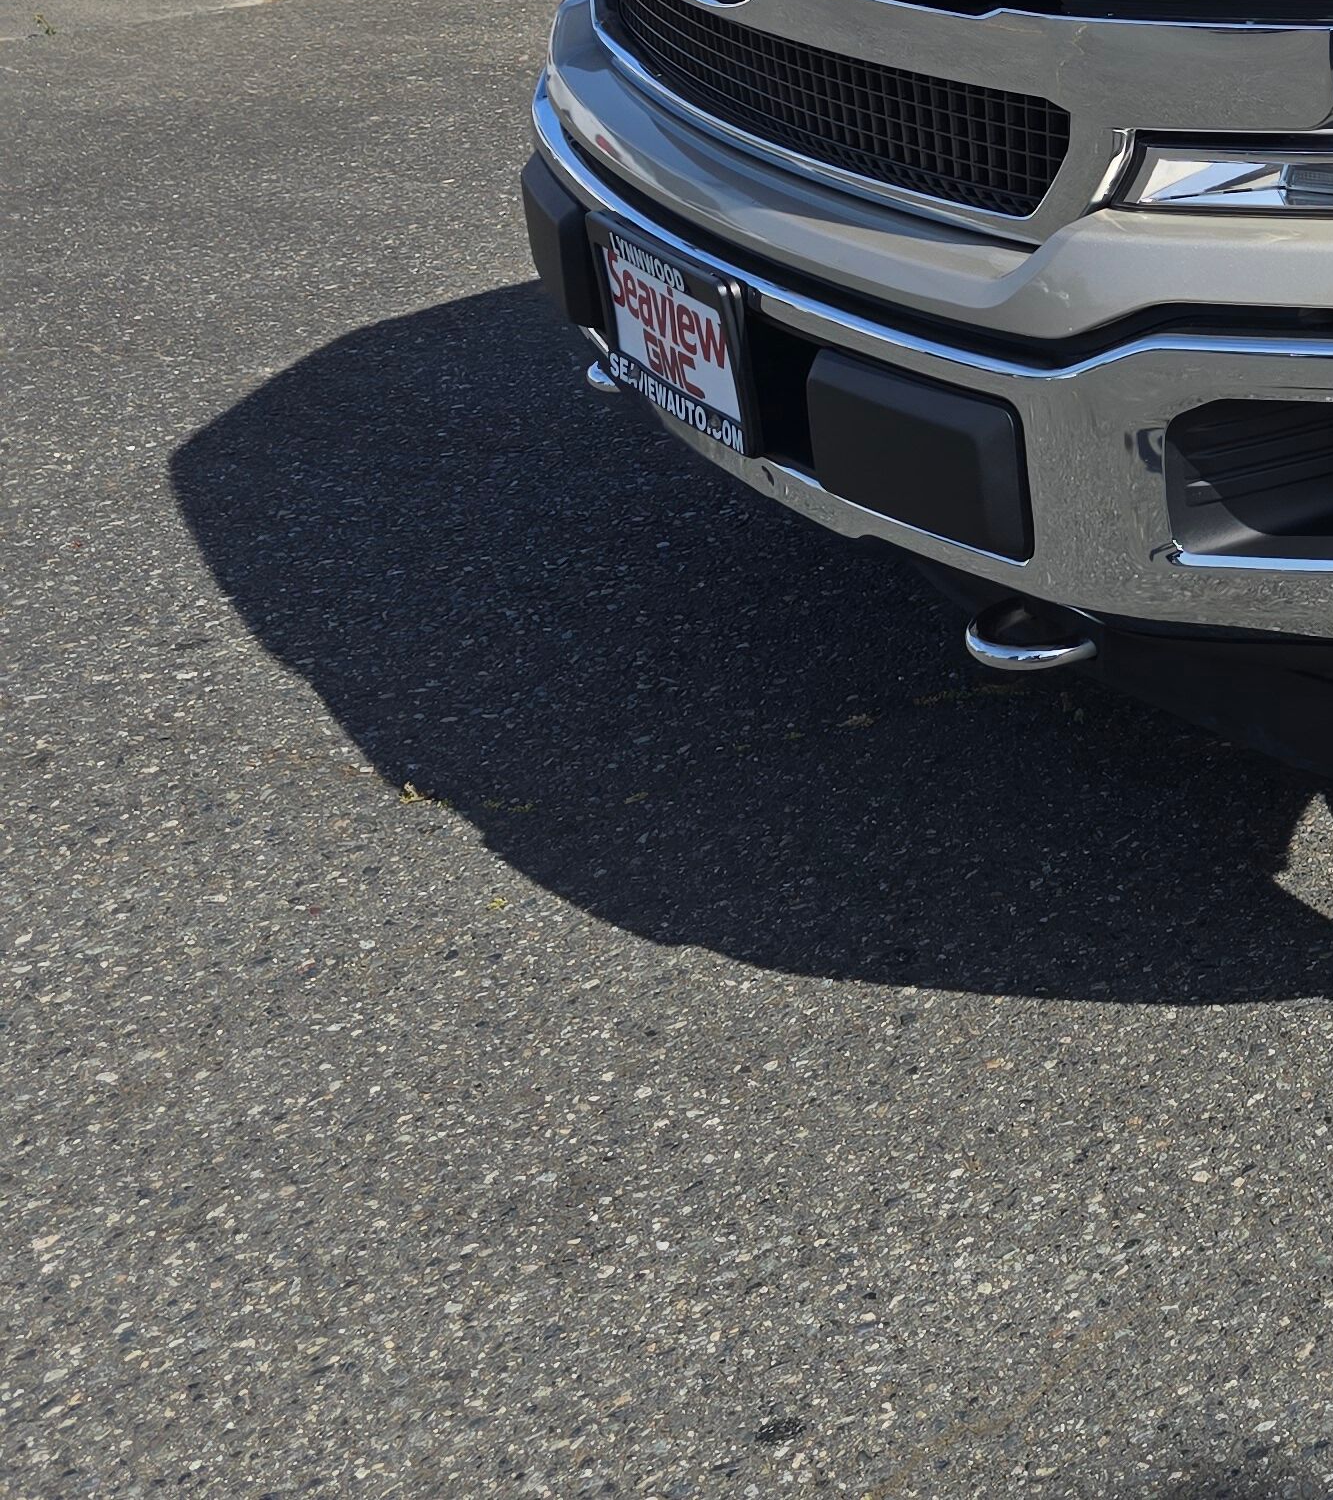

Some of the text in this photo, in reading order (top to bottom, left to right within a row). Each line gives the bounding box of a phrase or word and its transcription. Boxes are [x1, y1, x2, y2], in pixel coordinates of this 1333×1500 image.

[609, 232, 685, 292] LYNNWOOD
[608, 250, 728, 369] Seaview
[643, 328, 705, 400] GMC
